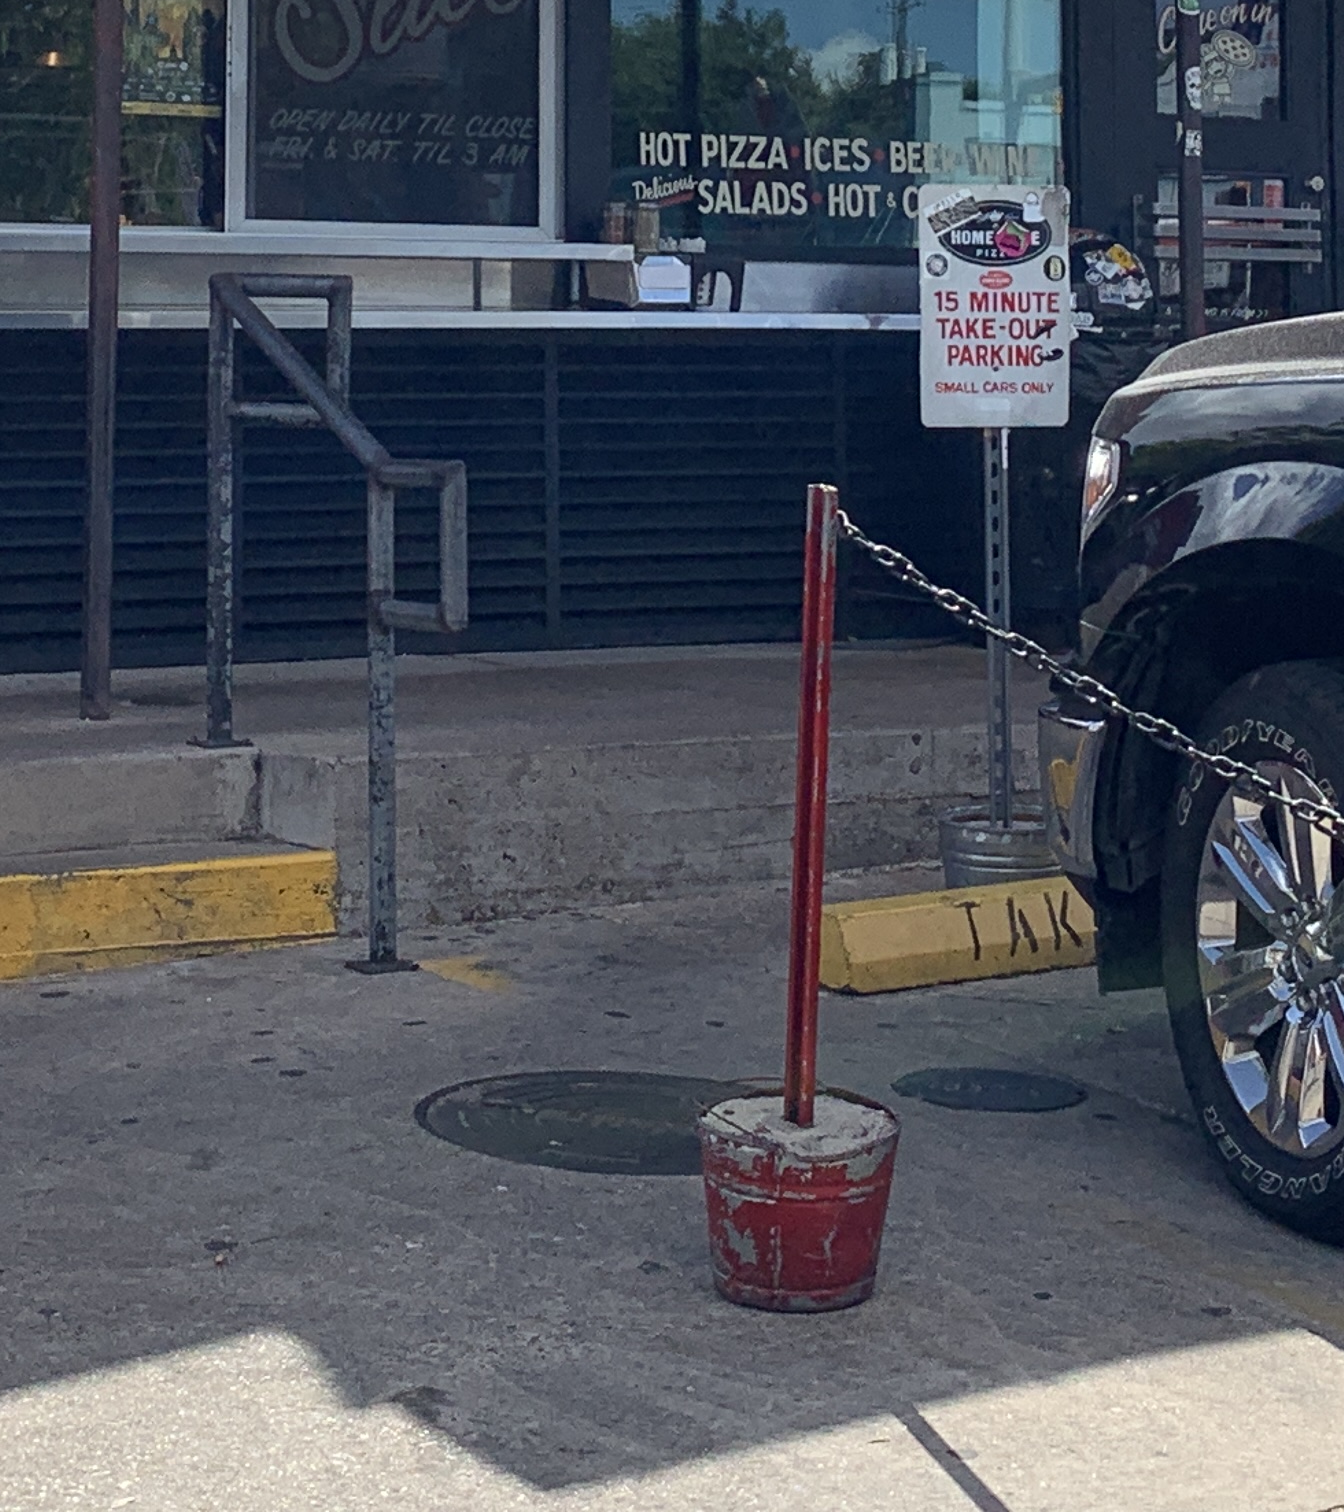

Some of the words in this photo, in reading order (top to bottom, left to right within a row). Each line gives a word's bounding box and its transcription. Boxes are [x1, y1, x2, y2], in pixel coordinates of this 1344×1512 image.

[1220, 3, 1246, 25] on
[1251, 1, 1272, 25] in
[269, 108, 335, 132] OPEN
[337, 110, 411, 134] DAILY
[465, 115, 536, 138] CLOSE
[461, 143, 479, 165] 3
[488, 144, 529, 166] AM
[639, 132, 691, 167] HOT
[701, 134, 788, 170] PIZZA
[804, 137, 871, 172] ICES
[632, 174, 699, 201] Delicious
[698, 179, 807, 216] SALADS
[828, 183, 881, 218] HOT
[951, 230, 994, 246] HOME
[976, 249, 1006, 258] PIZZ
[934, 292, 959, 312] 15
[969, 292, 1060, 313] MINUTE
[935, 318, 1058, 340] TAKE-OUT
[947, 345, 1045, 367] PARKING
[935, 382, 979, 394] SMALL
[983, 382, 1018, 394] CARS
[1021, 382, 1054, 394] ONLY
[955, 890, 1083, 961] TAK
